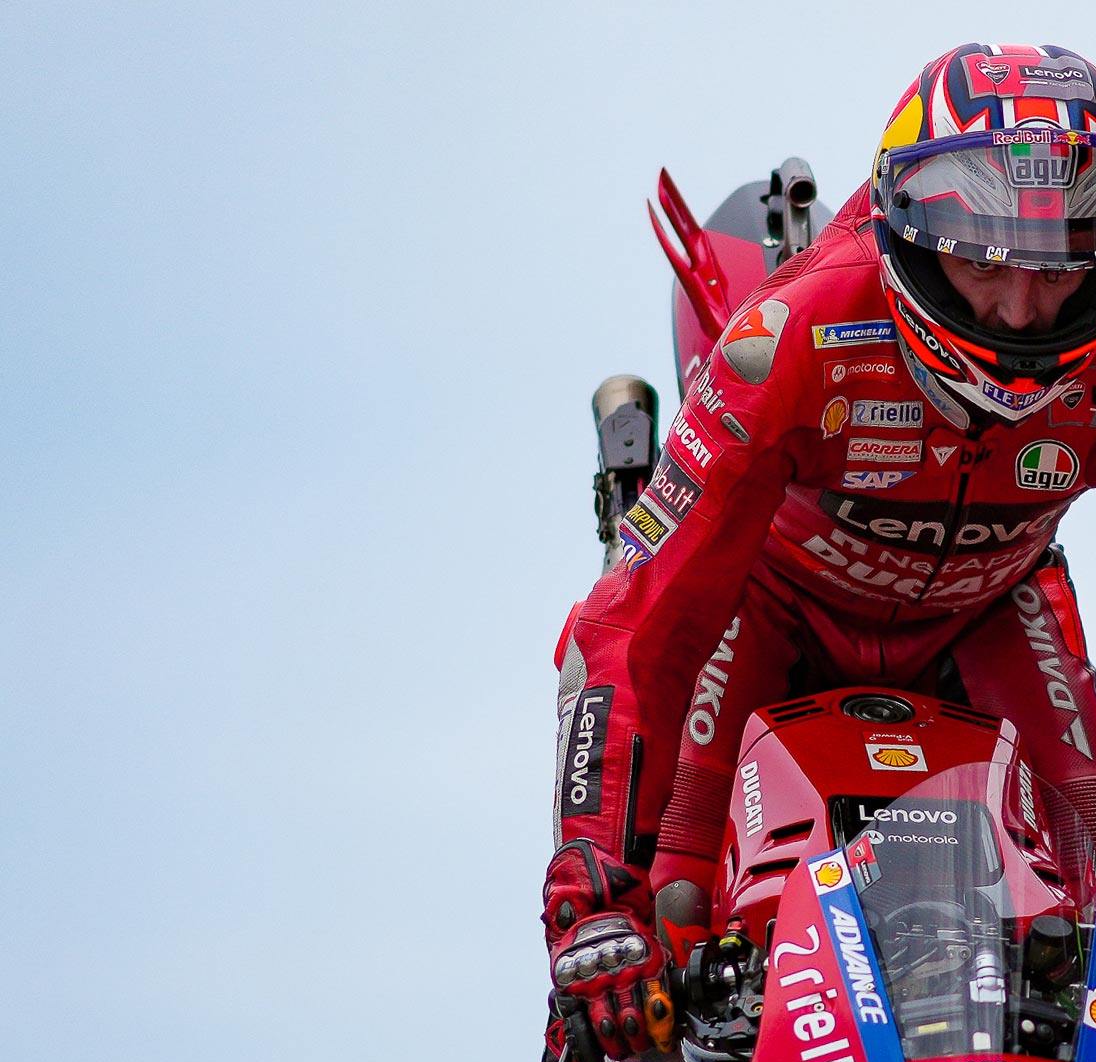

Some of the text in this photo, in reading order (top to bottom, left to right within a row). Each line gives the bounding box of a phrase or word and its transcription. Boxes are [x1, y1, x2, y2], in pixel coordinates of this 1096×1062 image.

[1024, 66, 1083, 79] Lenovo
[993, 130, 1051, 145] Red Bull
[1016, 158, 1068, 186] agv
[903, 224, 919, 242] CAT
[937, 237, 957, 253] CAT
[986, 246, 1009, 261] CAT
[840, 327, 891, 339] MICHELIN
[897, 299, 960, 370] Lenovo
[847, 361, 896, 375] motorola
[984, 381, 1046, 409] FLEX-BO
[870, 404, 922, 422] riello
[674, 413, 713, 469] DUCATI
[850, 441, 919, 455] CARRERA
[842, 471, 903, 489] SAP
[1024, 469, 1069, 489] agv
[836, 499, 1060, 547] Lenovo
[801, 534, 1041, 601] DUCATI
[1011, 583, 1079, 713] DAIKO
[570, 695, 604, 806] Lenovo
[740, 760, 764, 838] DUCATI
[1019, 759, 1038, 831] DUCATI
[859, 804, 958, 824] Lenovo
[887, 831, 959, 845] motorola
[828, 904, 888, 1025] ADVANCE
